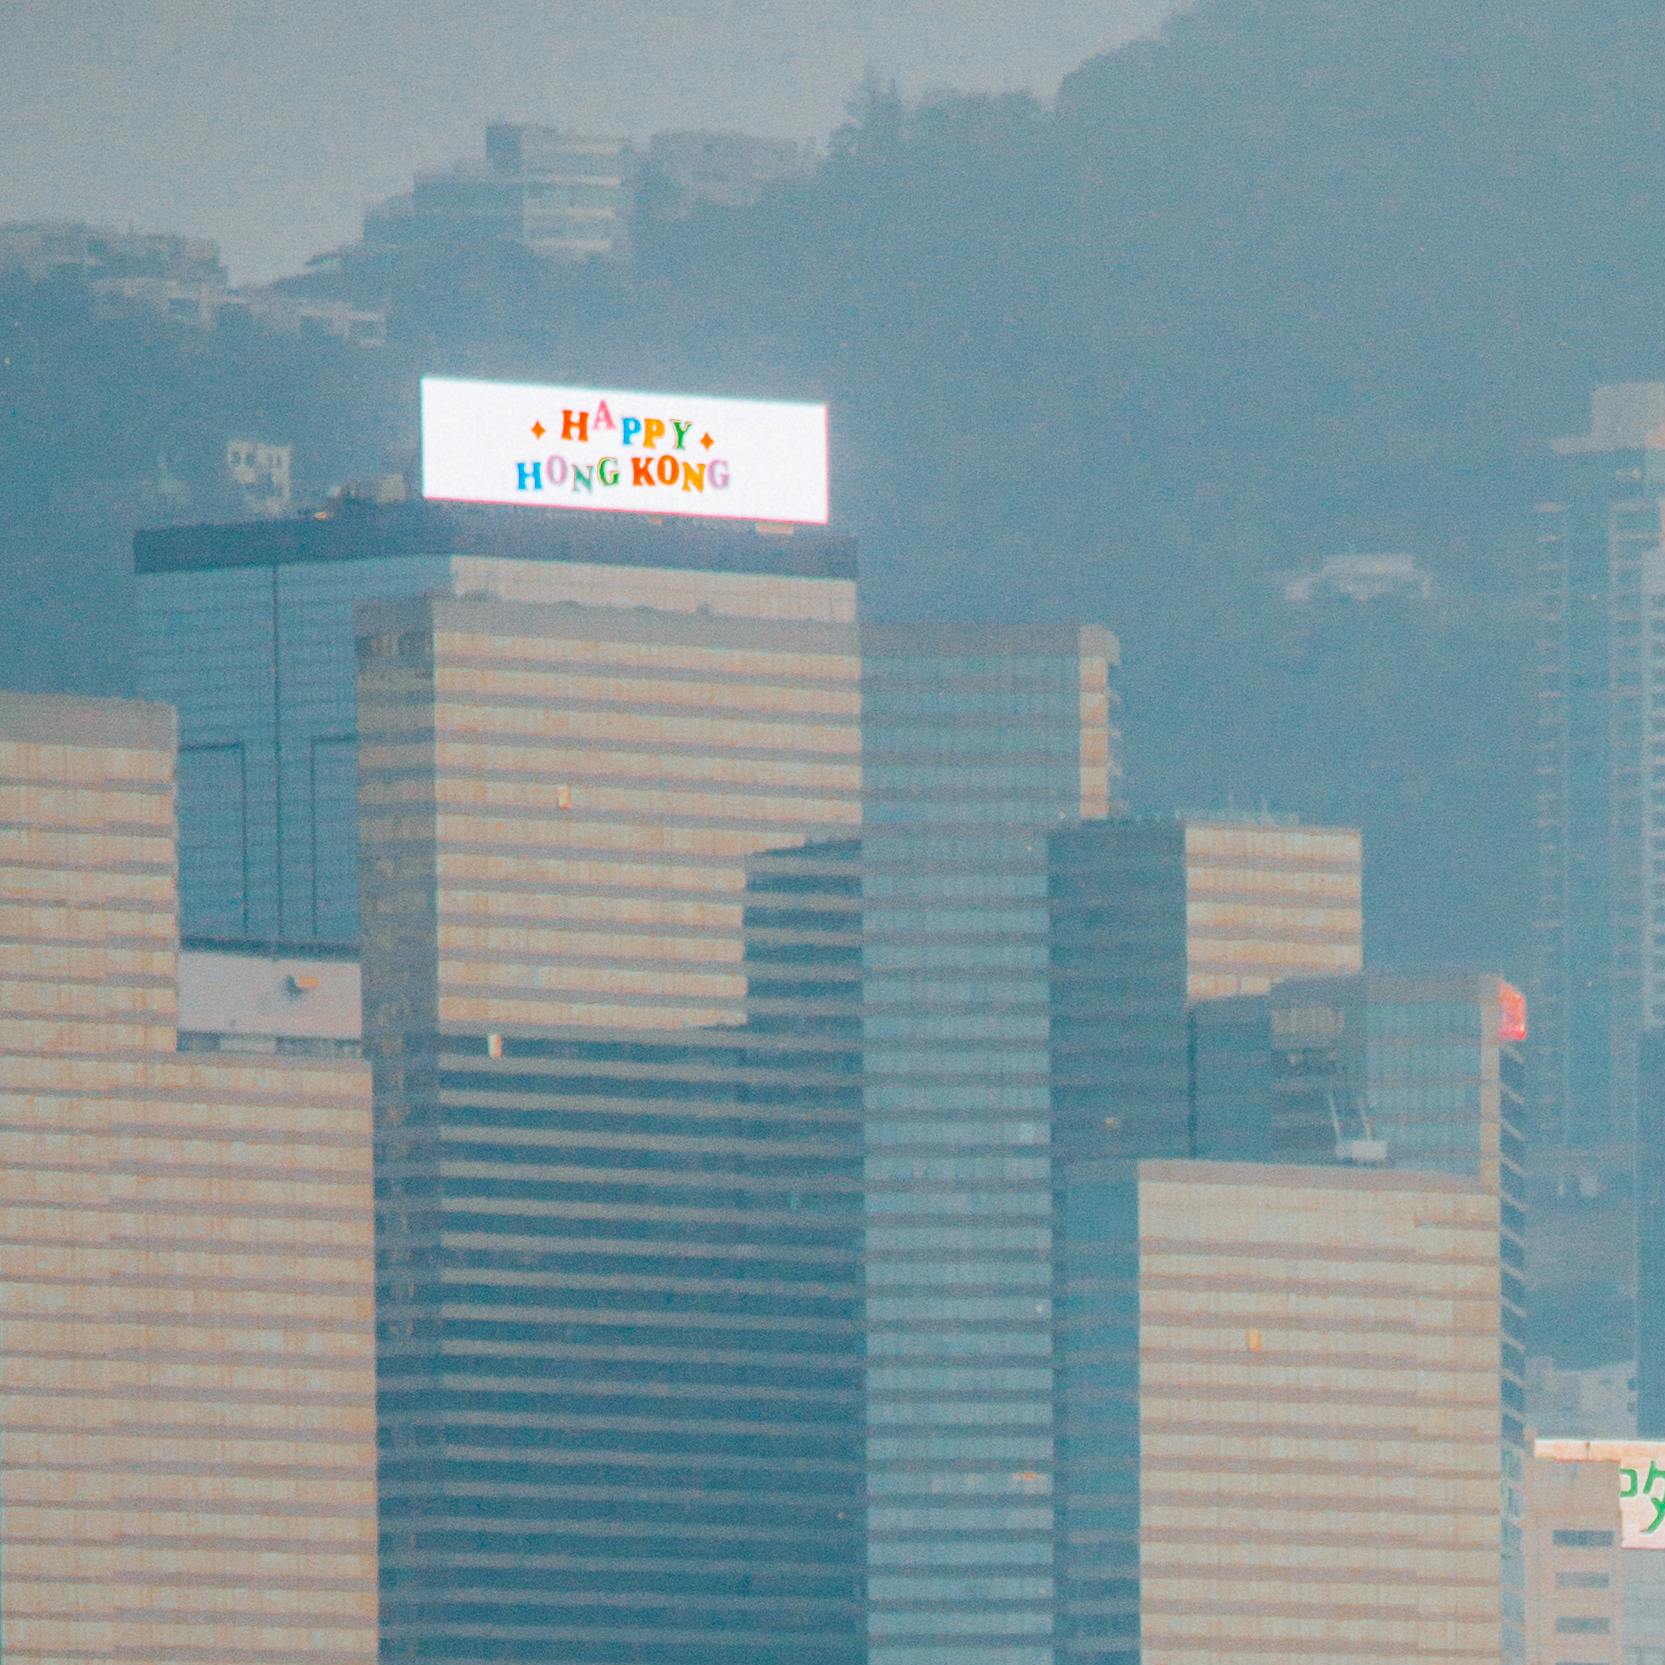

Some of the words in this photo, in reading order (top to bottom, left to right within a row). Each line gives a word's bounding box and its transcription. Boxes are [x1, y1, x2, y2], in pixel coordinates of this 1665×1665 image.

[560, 399, 694, 450] HAPPY
[515, 454, 620, 494] HONG
[631, 454, 731, 494] KONG
